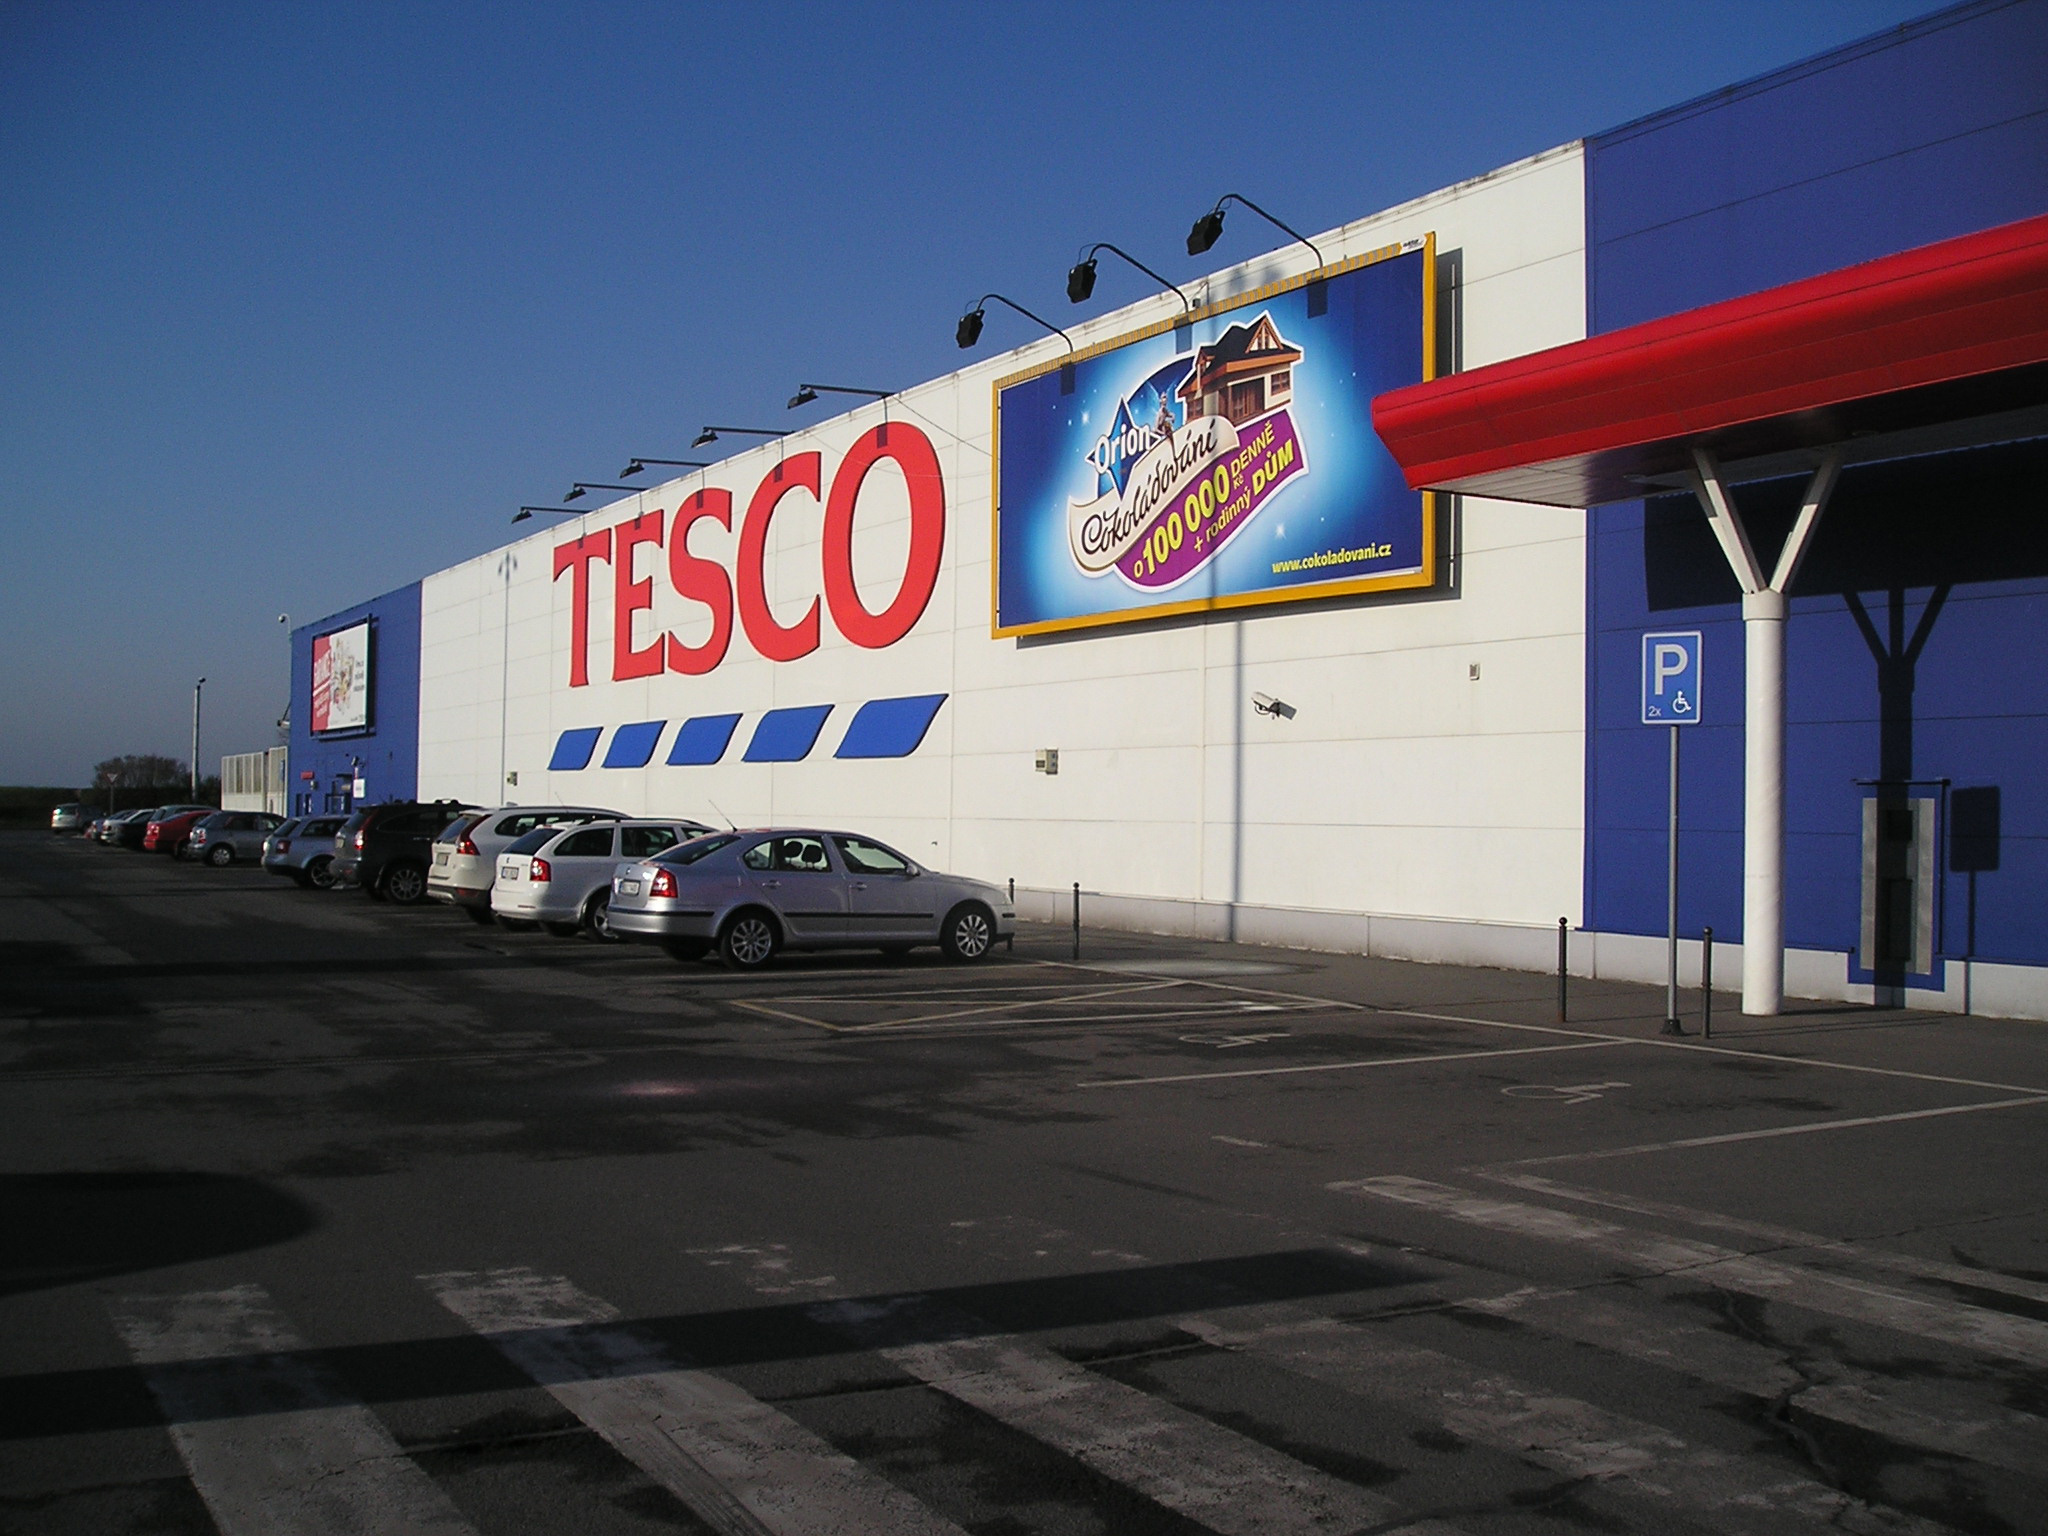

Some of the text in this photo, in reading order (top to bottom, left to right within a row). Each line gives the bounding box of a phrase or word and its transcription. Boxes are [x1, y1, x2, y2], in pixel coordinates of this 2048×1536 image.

[1093, 423, 1151, 474] Orion
[1133, 421, 1275, 578] o 100 000 DENNĚ
[1206, 486, 1251, 542] rodinný
[1252, 438, 1294, 496] DŮM
[1233, 474, 1244, 490] Kč
[553, 421, 946, 687] TESCO
[1272, 542, 1392, 573] www.cokoladovani.cz
[1654, 643, 1689, 696] P
[1648, 705, 1662, 717] 2x
